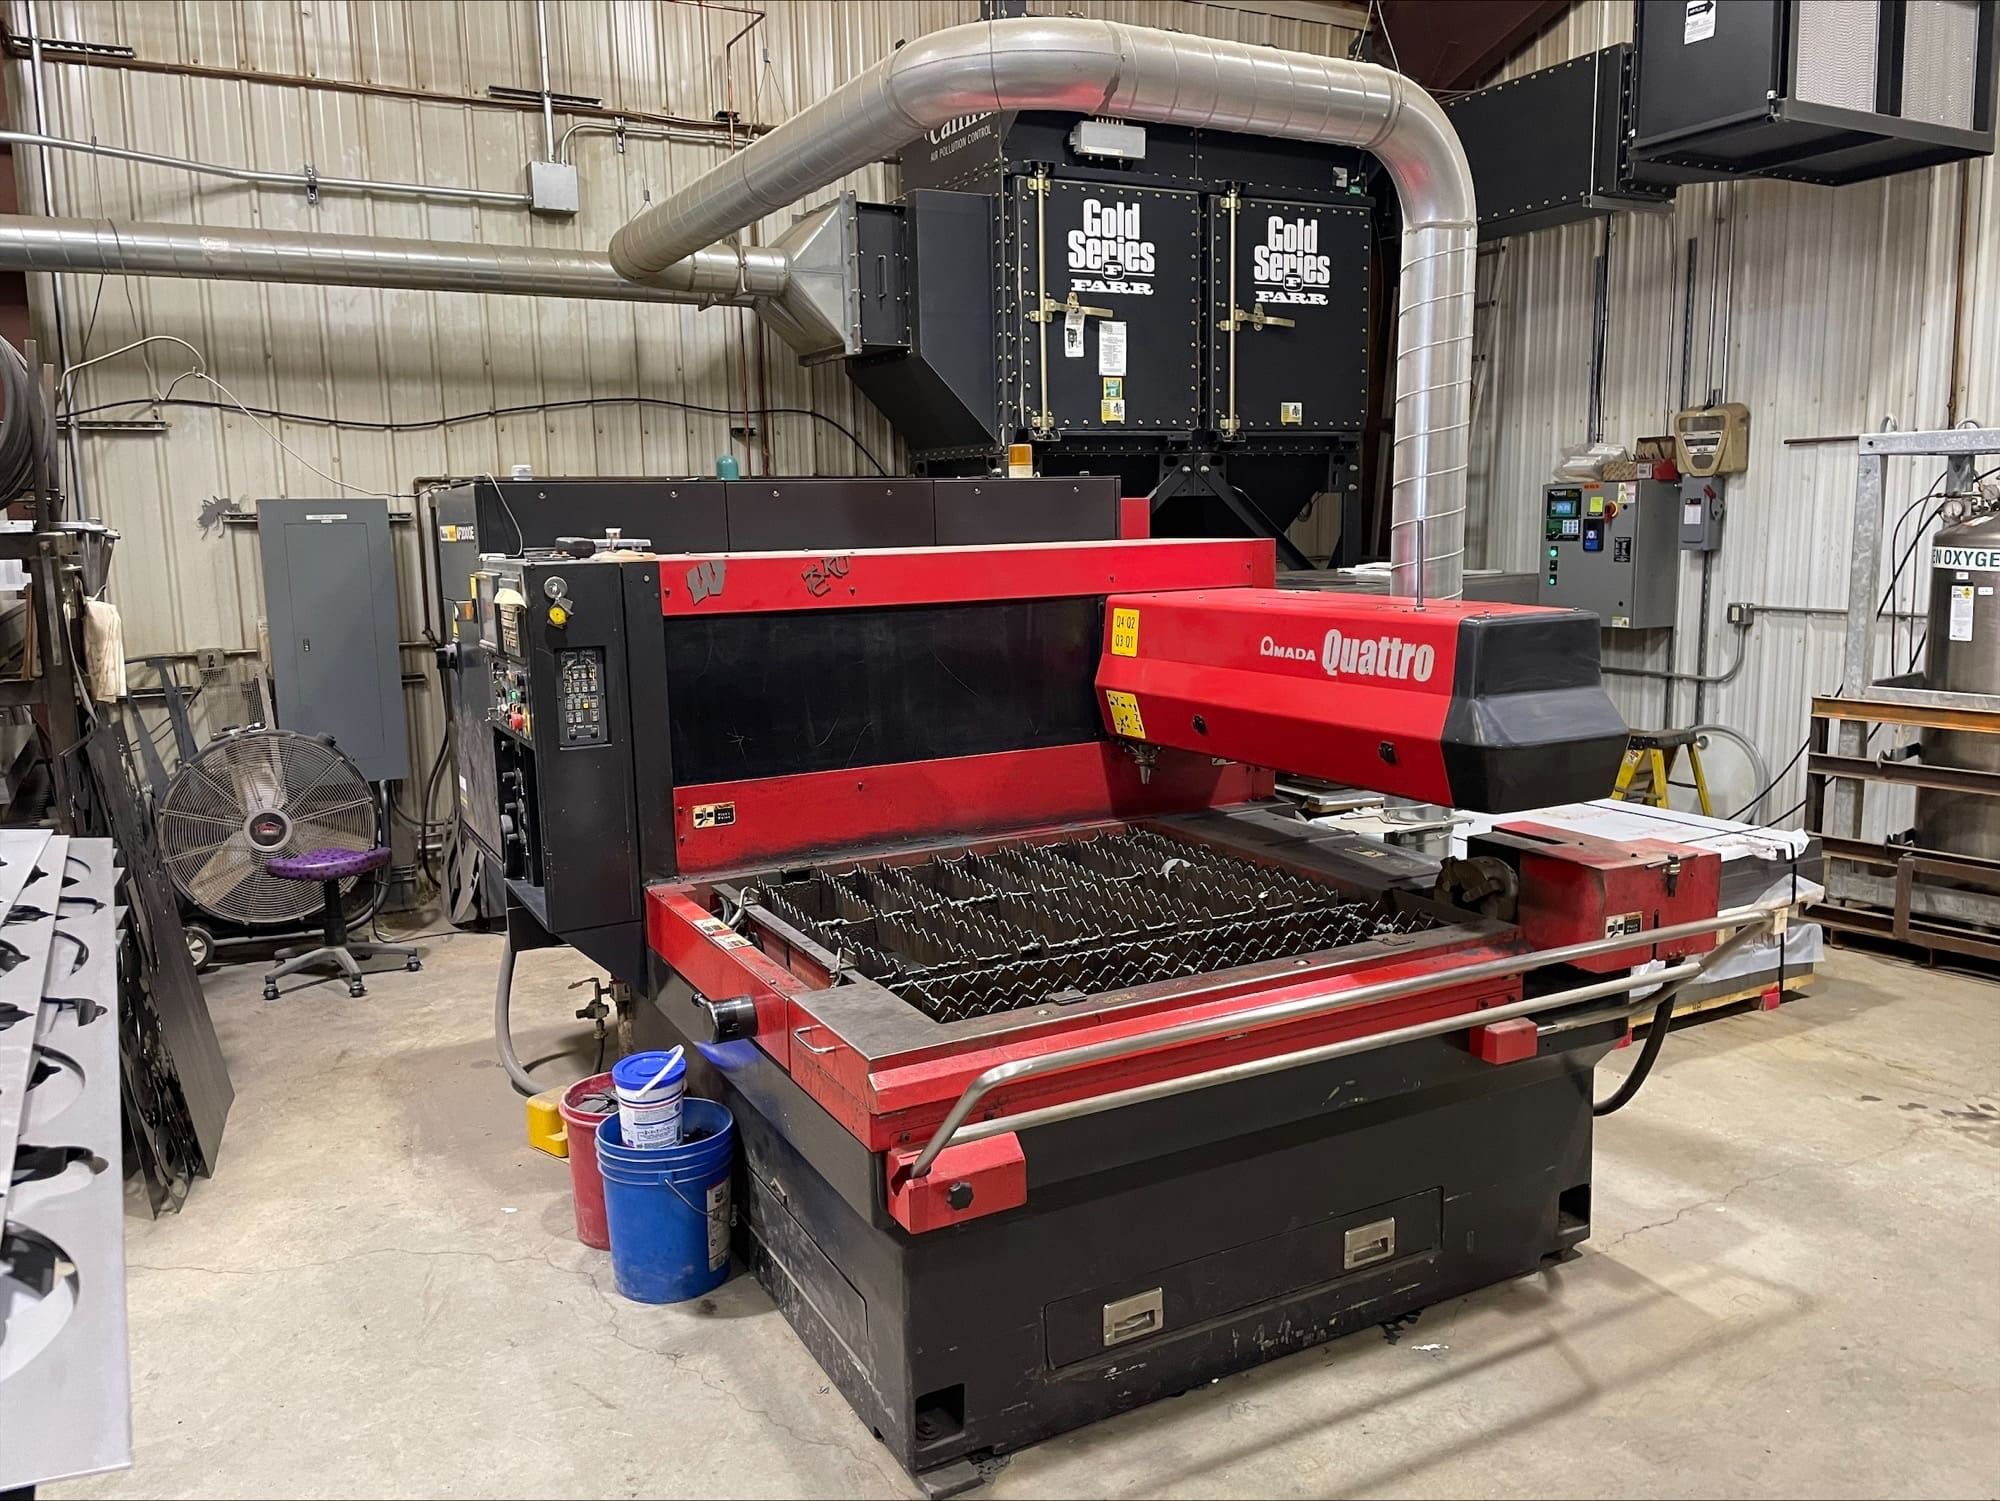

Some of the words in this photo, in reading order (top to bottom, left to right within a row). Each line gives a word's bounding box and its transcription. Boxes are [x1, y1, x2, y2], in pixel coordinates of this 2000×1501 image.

[939, 137, 967, 158] POLLUTION
[967, 124, 992, 145] CONTROL
[1083, 198, 1140, 240] Gold
[1267, 215, 1318, 254] Gold
[1068, 229, 1155, 273] Series
[1254, 245, 1331, 285] Series
[1070, 278, 1154, 296] FARR
[1255, 290, 1329, 306] FARR
[1322, 628, 1435, 682] Quattro
